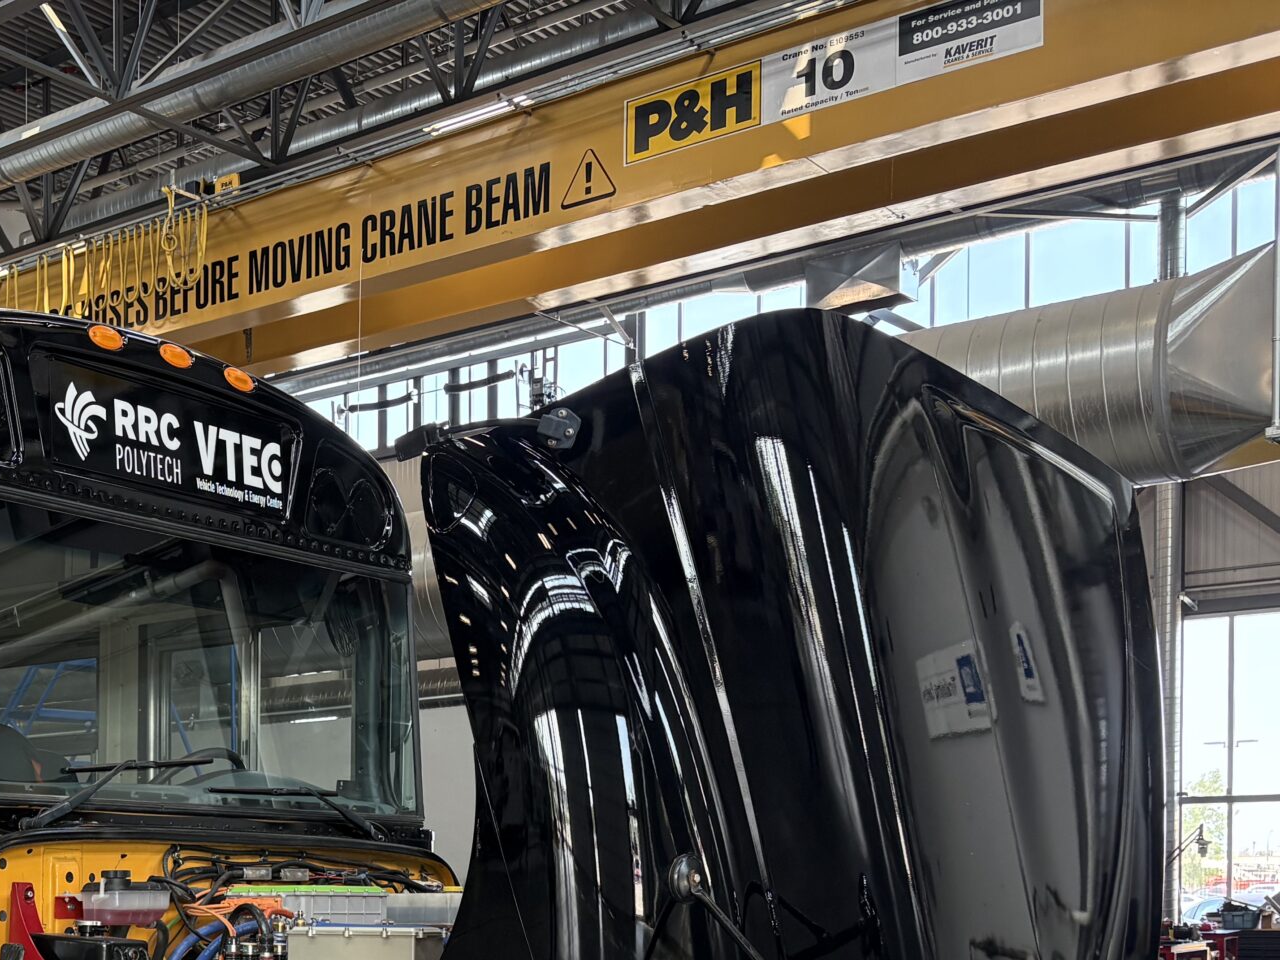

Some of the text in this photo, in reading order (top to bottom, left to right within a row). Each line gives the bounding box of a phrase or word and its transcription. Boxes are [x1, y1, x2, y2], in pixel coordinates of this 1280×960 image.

[911, 19, 926, 28] For
[928, 8, 962, 23] Service
[964, 1, 981, 12] and
[912, 2, 1022, 45] 800-933-3001
[782, 48, 808, 61] Crane
[944, 35, 997, 59] KAVERIT
[944, 55, 964, 65] CRANES
[971, 47, 994, 58] SERVICE
[796, 49, 855, 97] 10
[634, 70, 753, 154] P&H
[781, 105, 803, 116] Rated
[805, 94, 838, 109] Capacity
[154, 255, 240, 321] BEFORE
[248, 222, 351, 295] MOVING
[361, 190, 454, 263] CRANE
[465, 162, 551, 235] BEAM
[113, 398, 181, 451] RRC
[115, 444, 182, 485] POLYTECH
[193, 421, 283, 494] VTEC
[196, 477, 216, 493] Vehicle
[216, 482, 244, 502] Technology
[249, 491, 266, 508] Energy
[266, 495, 283, 509] Centre
